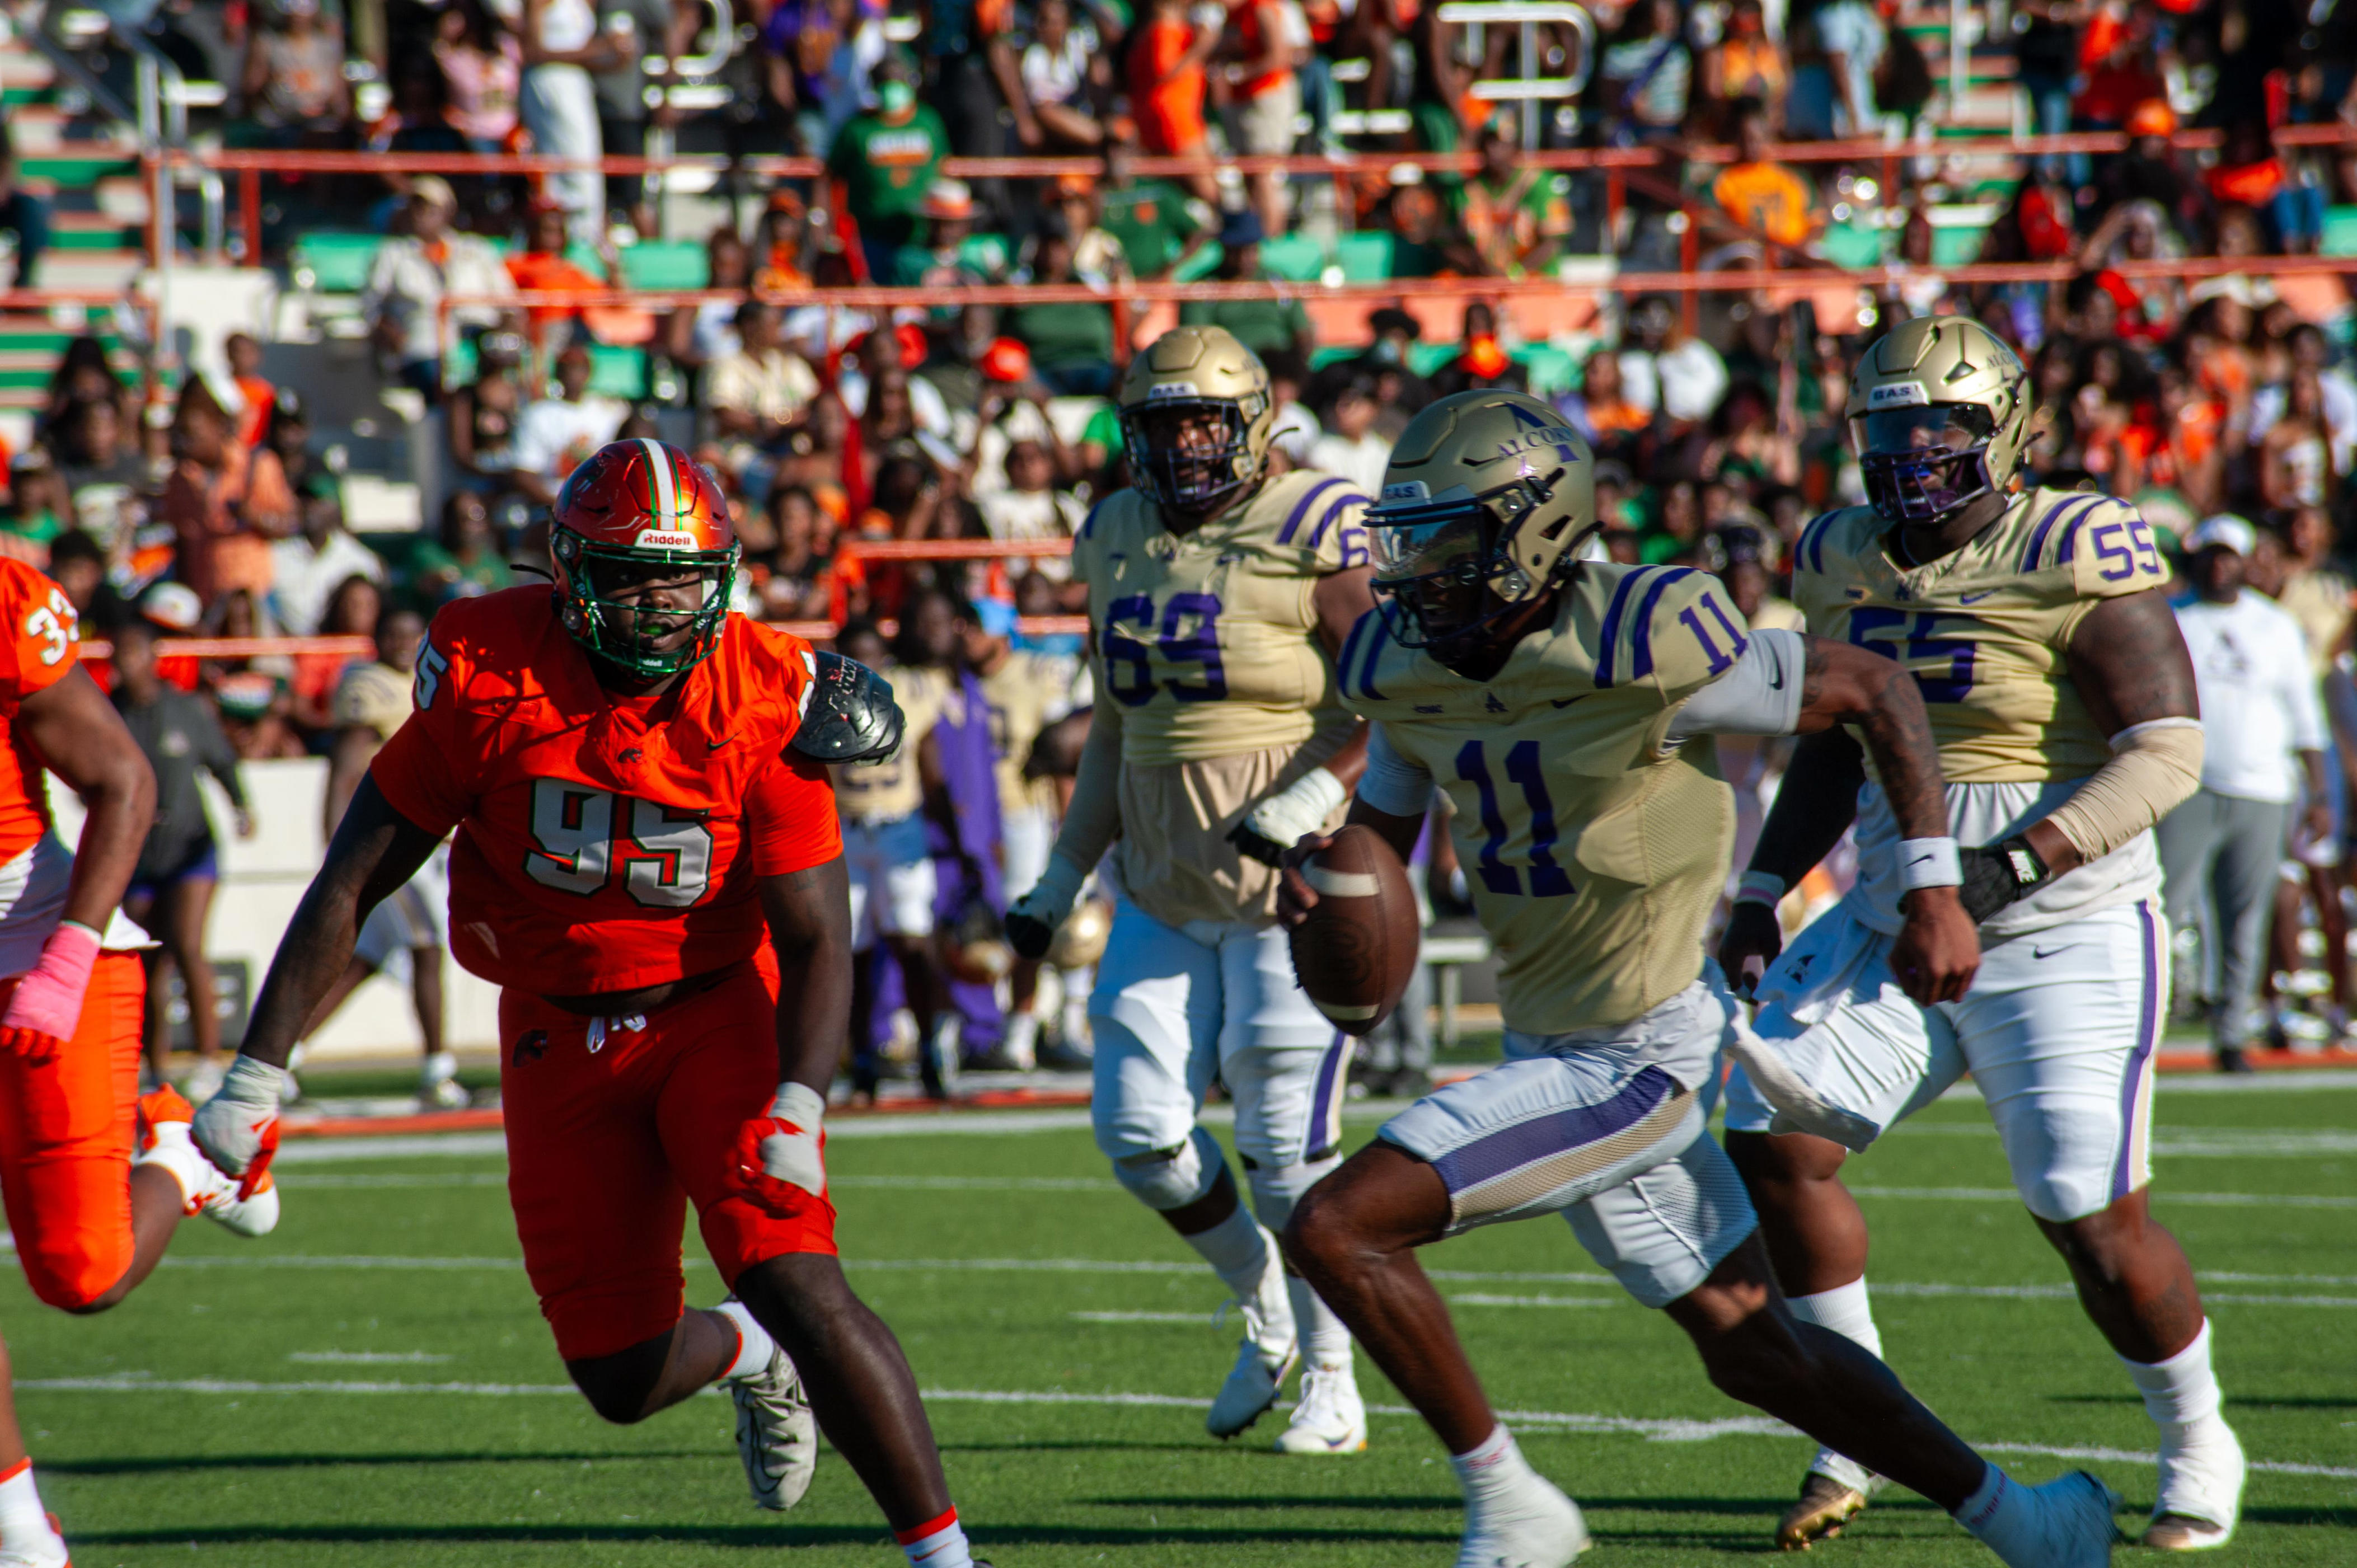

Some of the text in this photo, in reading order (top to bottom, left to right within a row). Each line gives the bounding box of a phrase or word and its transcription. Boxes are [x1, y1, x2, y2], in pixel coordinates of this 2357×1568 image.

[2090, 521, 2160, 582] 55
[414, 627, 449, 712] 5
[1104, 592, 1229, 707] 69
[1677, 591, 1748, 677] 11
[521, 777, 715, 908] 95
[1455, 740, 1577, 898] 11
